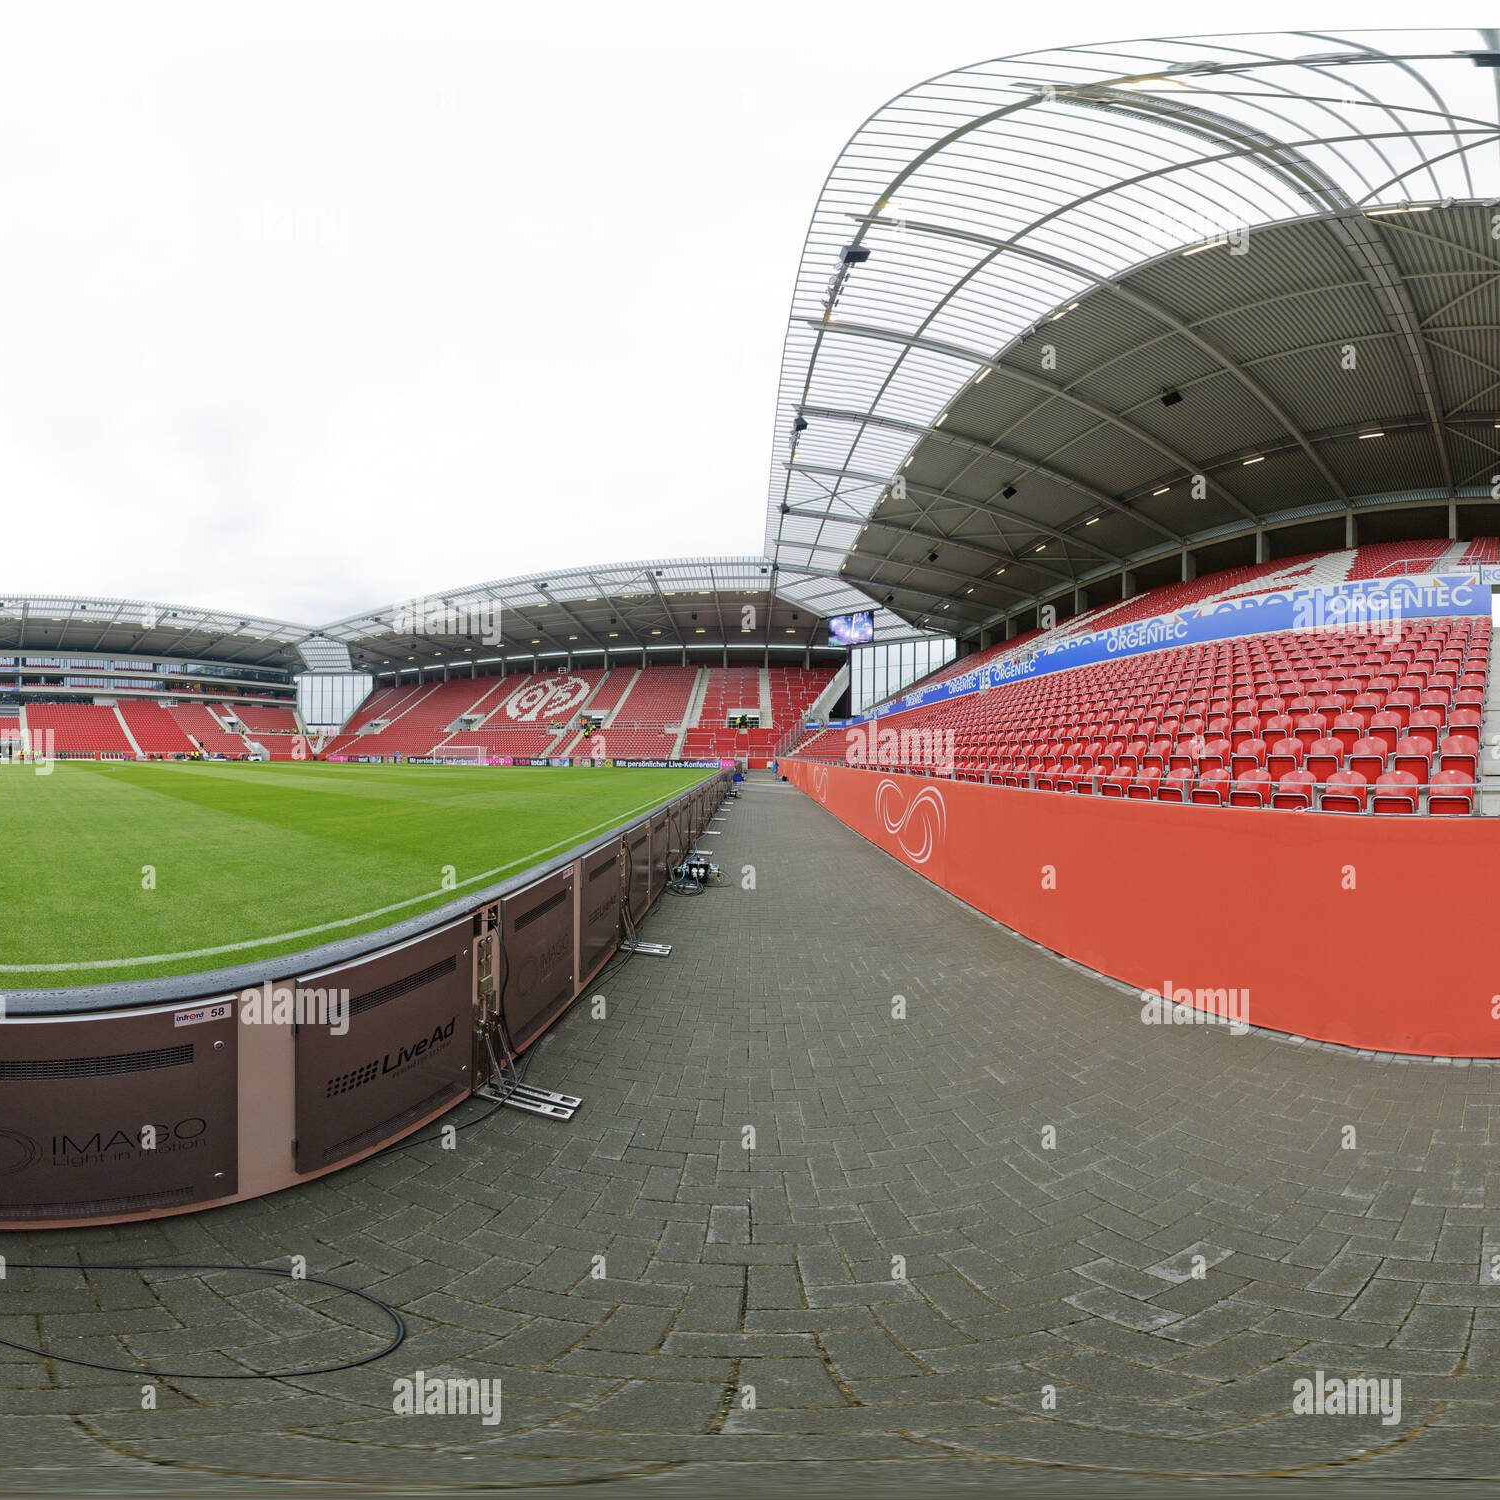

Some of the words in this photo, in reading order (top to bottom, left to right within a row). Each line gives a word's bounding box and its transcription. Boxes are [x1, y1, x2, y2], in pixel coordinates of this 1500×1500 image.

[1329, 585, 1473, 615] ORGENTEC
[1106, 621, 1189, 653] ORGENTEC
[994, 659, 1036, 681] ORGENTEC
[616, 760, 626, 768] Mit
[628, 759, 667, 769] persönlicher
[211, 1007, 225, 1018] 58
[381, 1016, 456, 1075] LiveAd
[52, 1117, 207, 1155] IMAGO
[52, 1152, 105, 1168] Light
[114, 1150, 131, 1162] in
